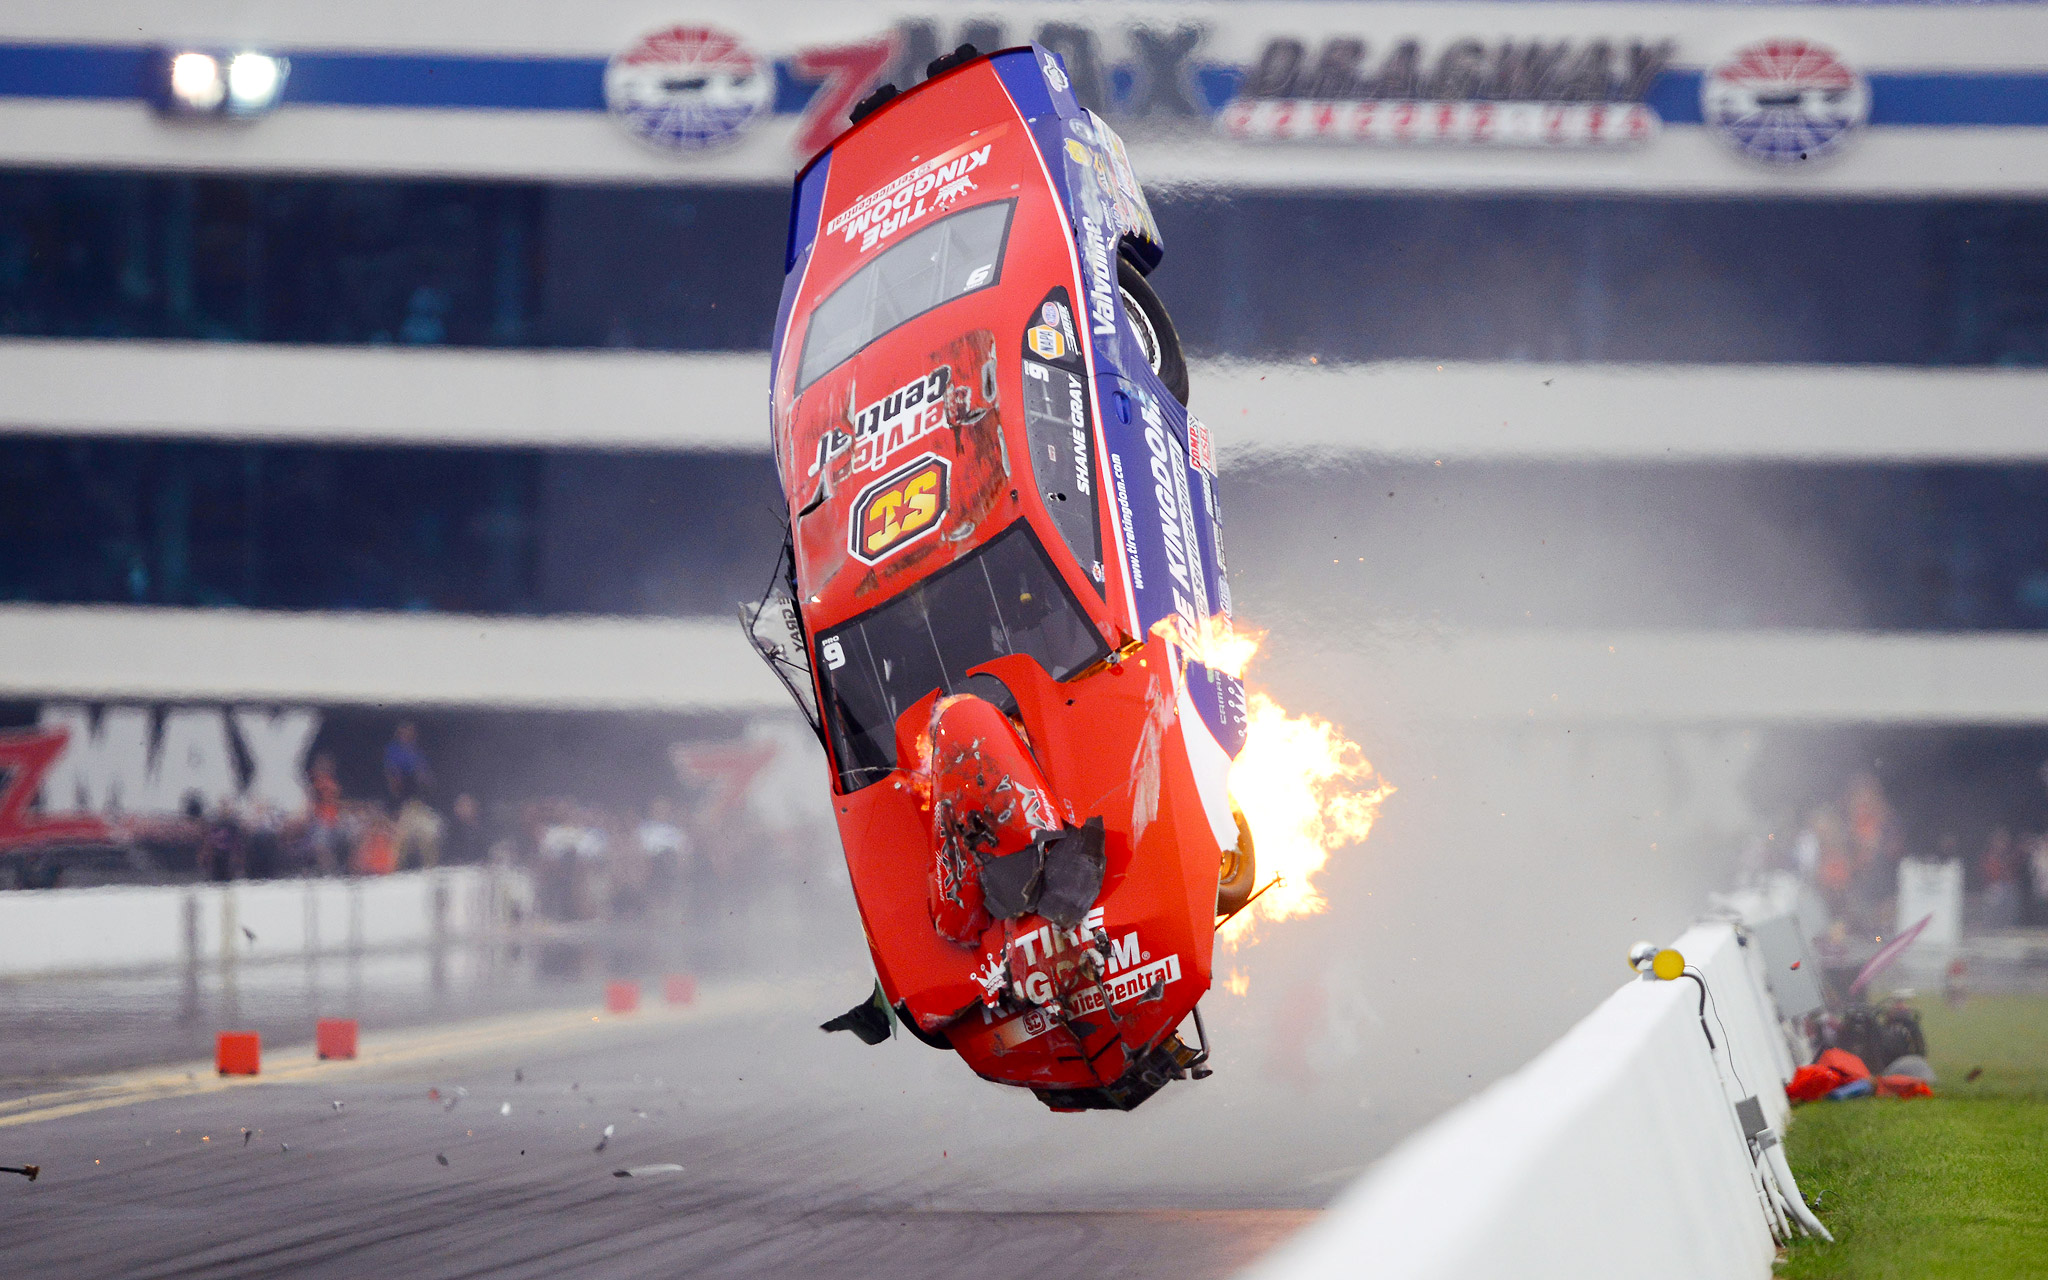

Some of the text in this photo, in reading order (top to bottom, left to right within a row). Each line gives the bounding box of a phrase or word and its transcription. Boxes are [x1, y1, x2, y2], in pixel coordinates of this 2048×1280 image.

[844, 144, 991, 242] KINGDOM
[860, 199, 926, 252] TIRE
[1029, 361, 1049, 382] 9
[1038, 328, 1055, 354] NAPA
[1068, 372, 1085, 428] GRAY
[832, 396, 958, 486] ervice
[1073, 430, 1090, 496] SHANE
[1190, 426, 1202, 470] COMP
[1202, 427, 1212, 469] JESEL
[867, 470, 937, 552] SC
[1110, 453, 1145, 590] www.tirekingdom.com
[1139, 402, 1203, 665] IRE KINGDOM
[1174, 447, 1206, 593] ServiceCentral
[823, 643, 846, 670] 9
[1214, 669, 1227, 725] CAMAR
[1050, 959, 1173, 1025] viceCentral
